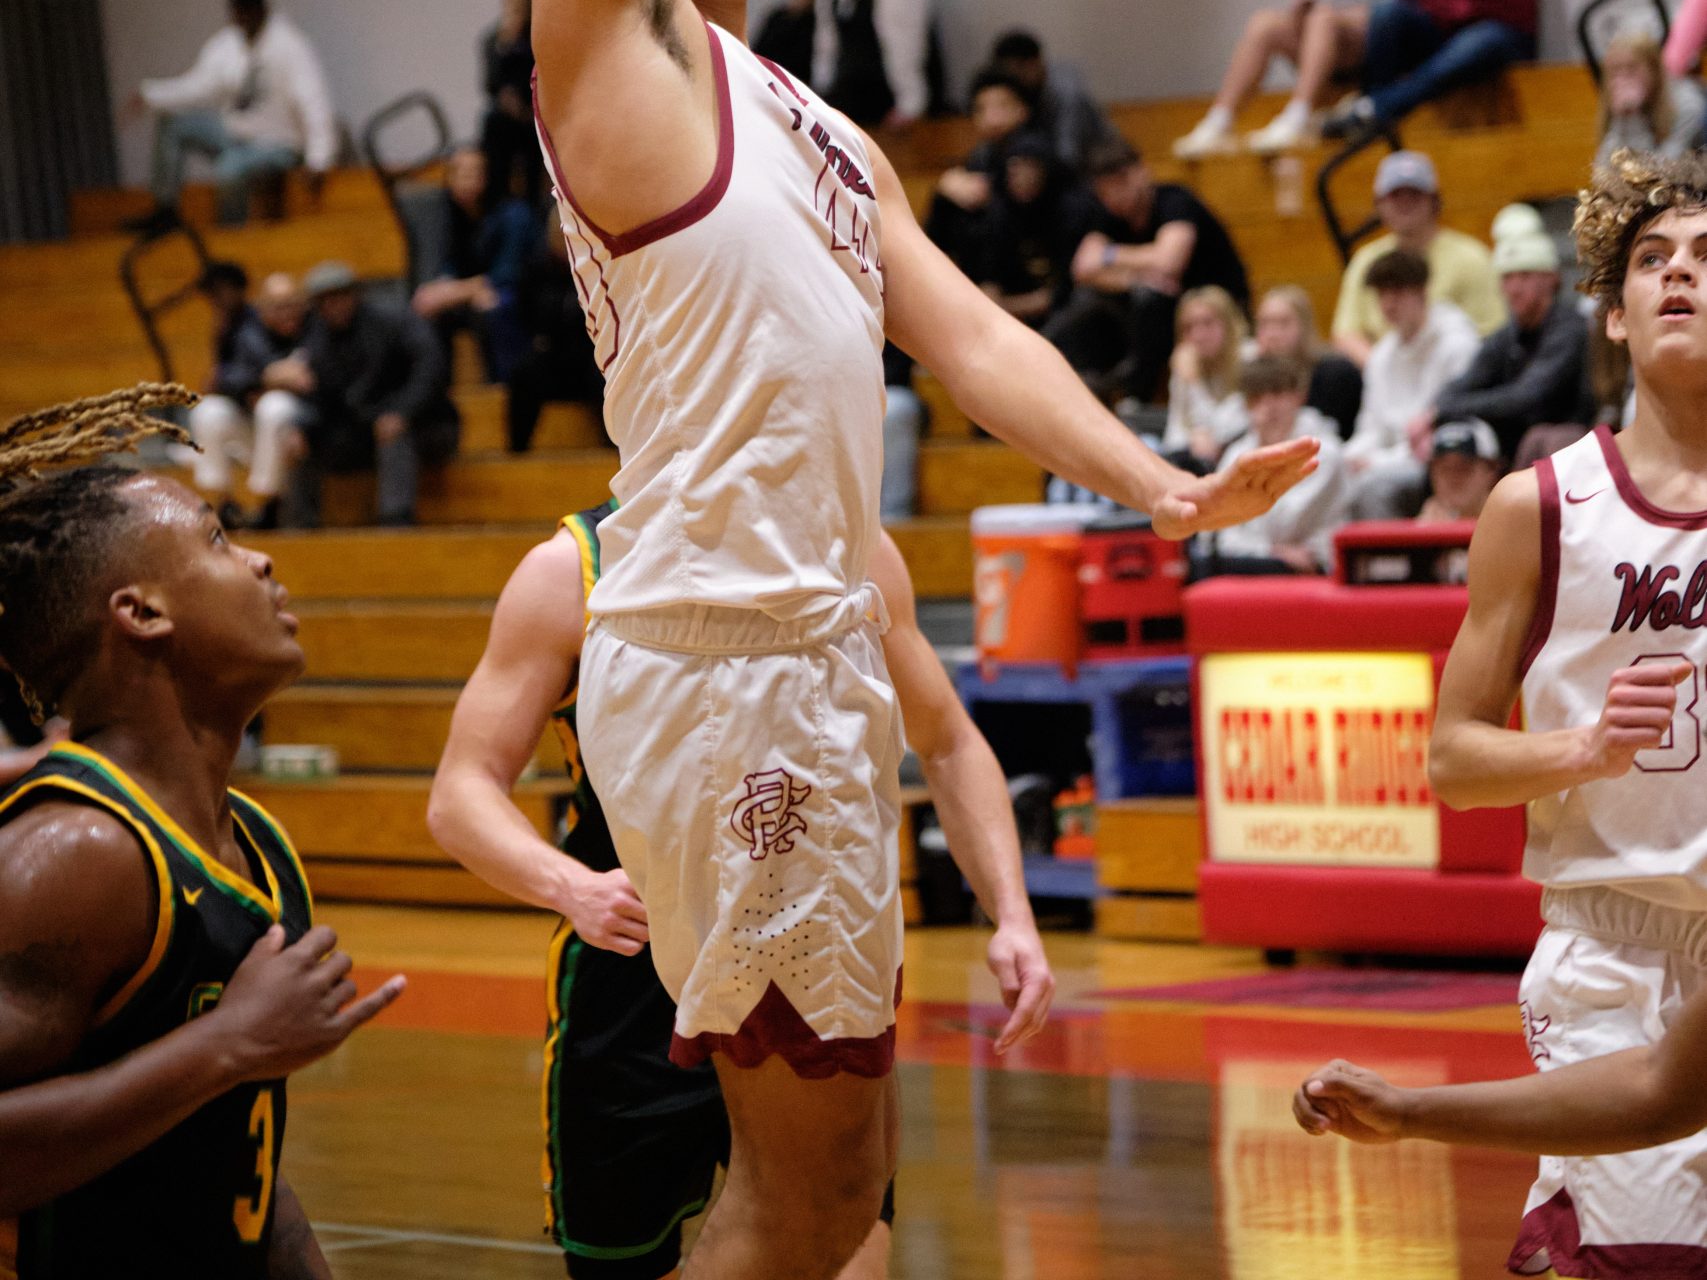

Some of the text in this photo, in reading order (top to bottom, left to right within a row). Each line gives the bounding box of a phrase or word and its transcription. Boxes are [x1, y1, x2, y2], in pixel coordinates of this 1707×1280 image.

[1611, 560, 1707, 632] Wol
[1247, 823, 1411, 855] HIGH SCHOOL
[233, 1088, 275, 1243] 3
